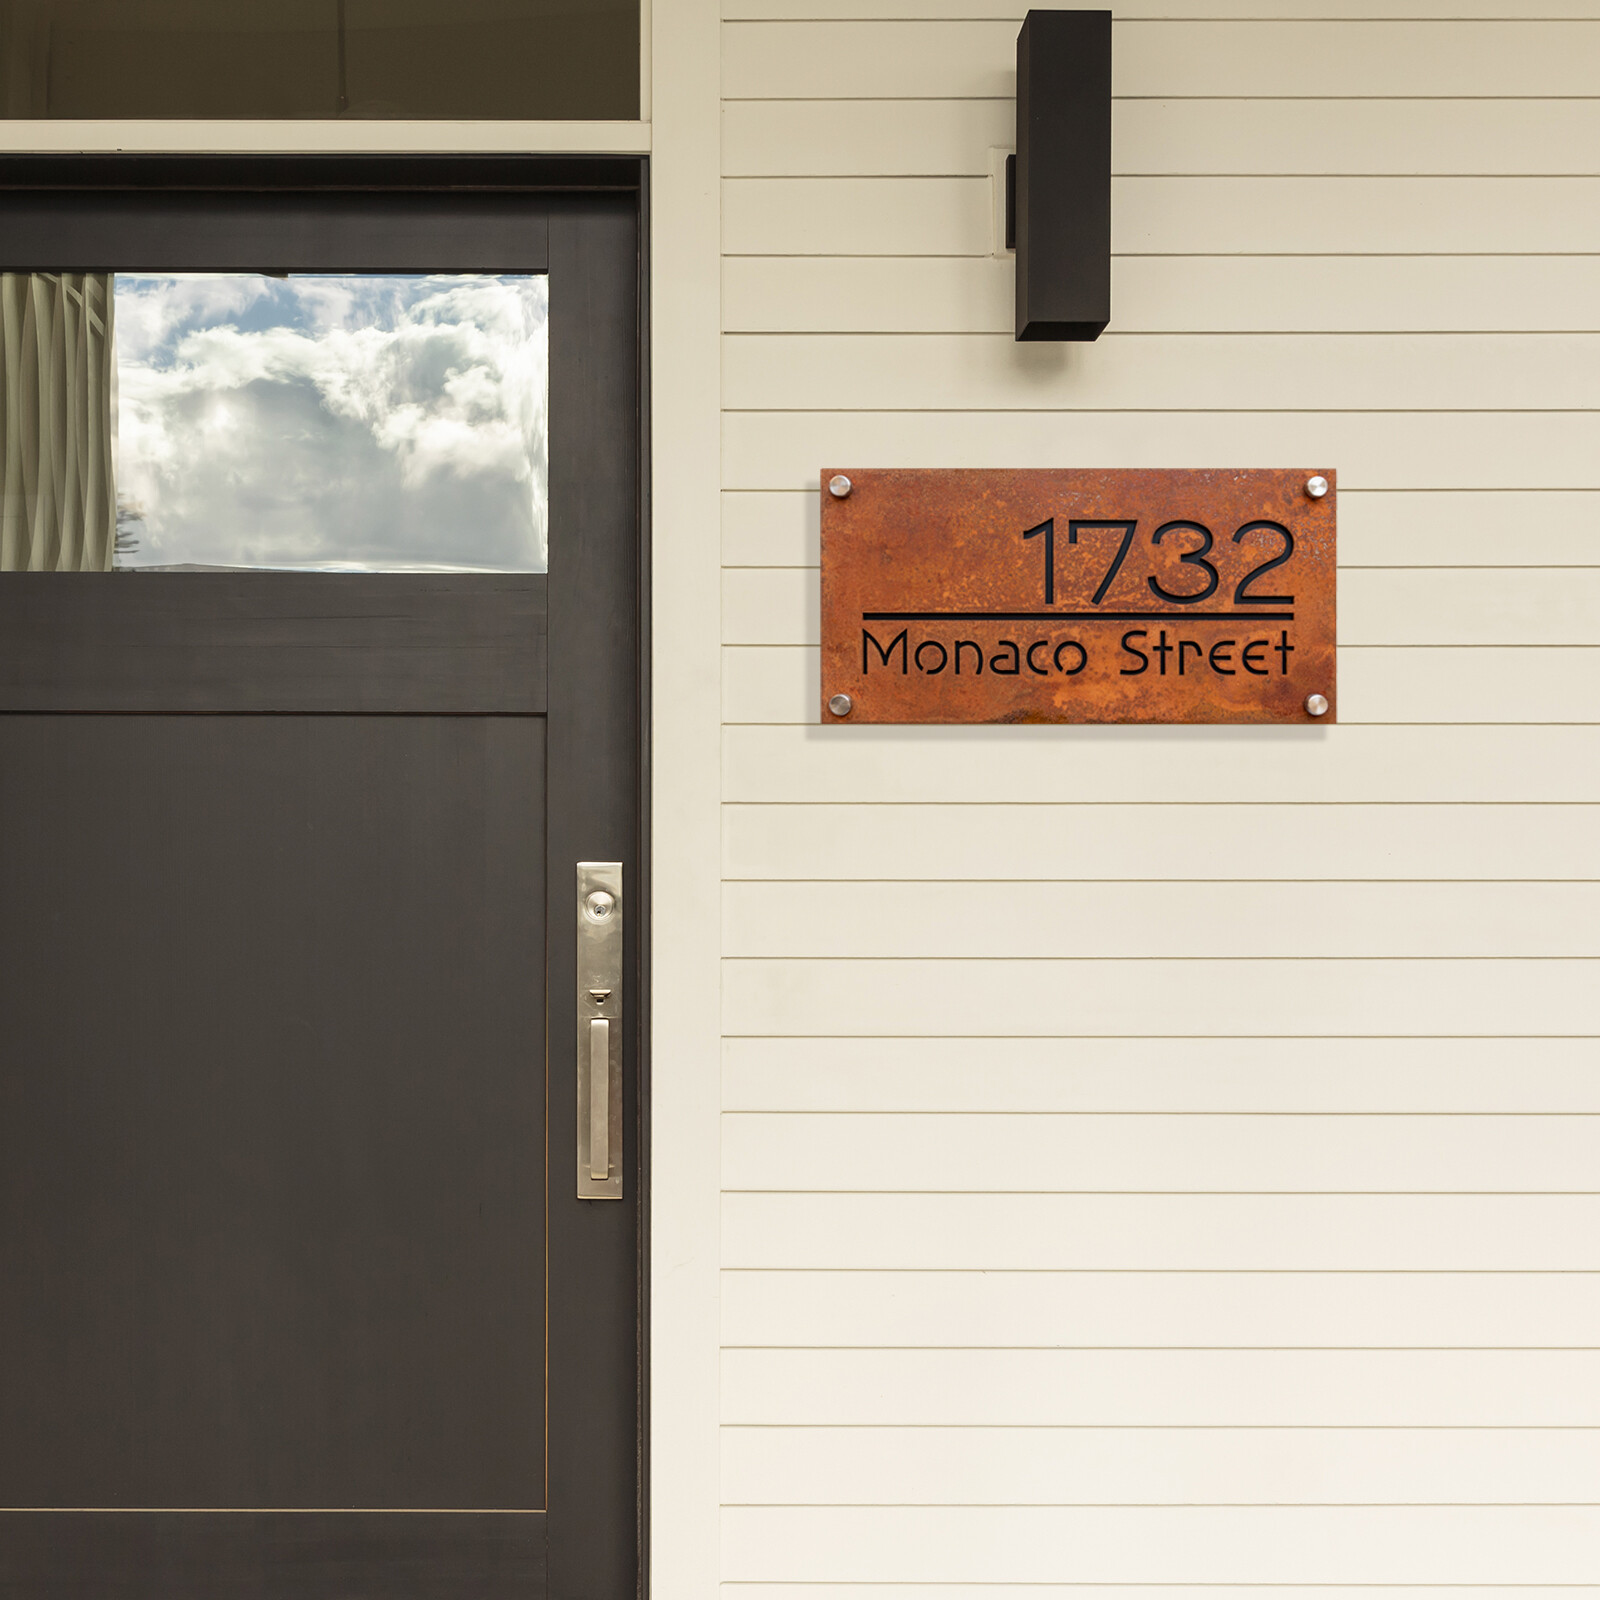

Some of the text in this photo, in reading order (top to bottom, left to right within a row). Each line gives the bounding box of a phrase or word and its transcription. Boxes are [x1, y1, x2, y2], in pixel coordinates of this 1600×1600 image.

[1023, 517, 1295, 606] 1732
[862, 628, 1295, 676] Monaco Street
